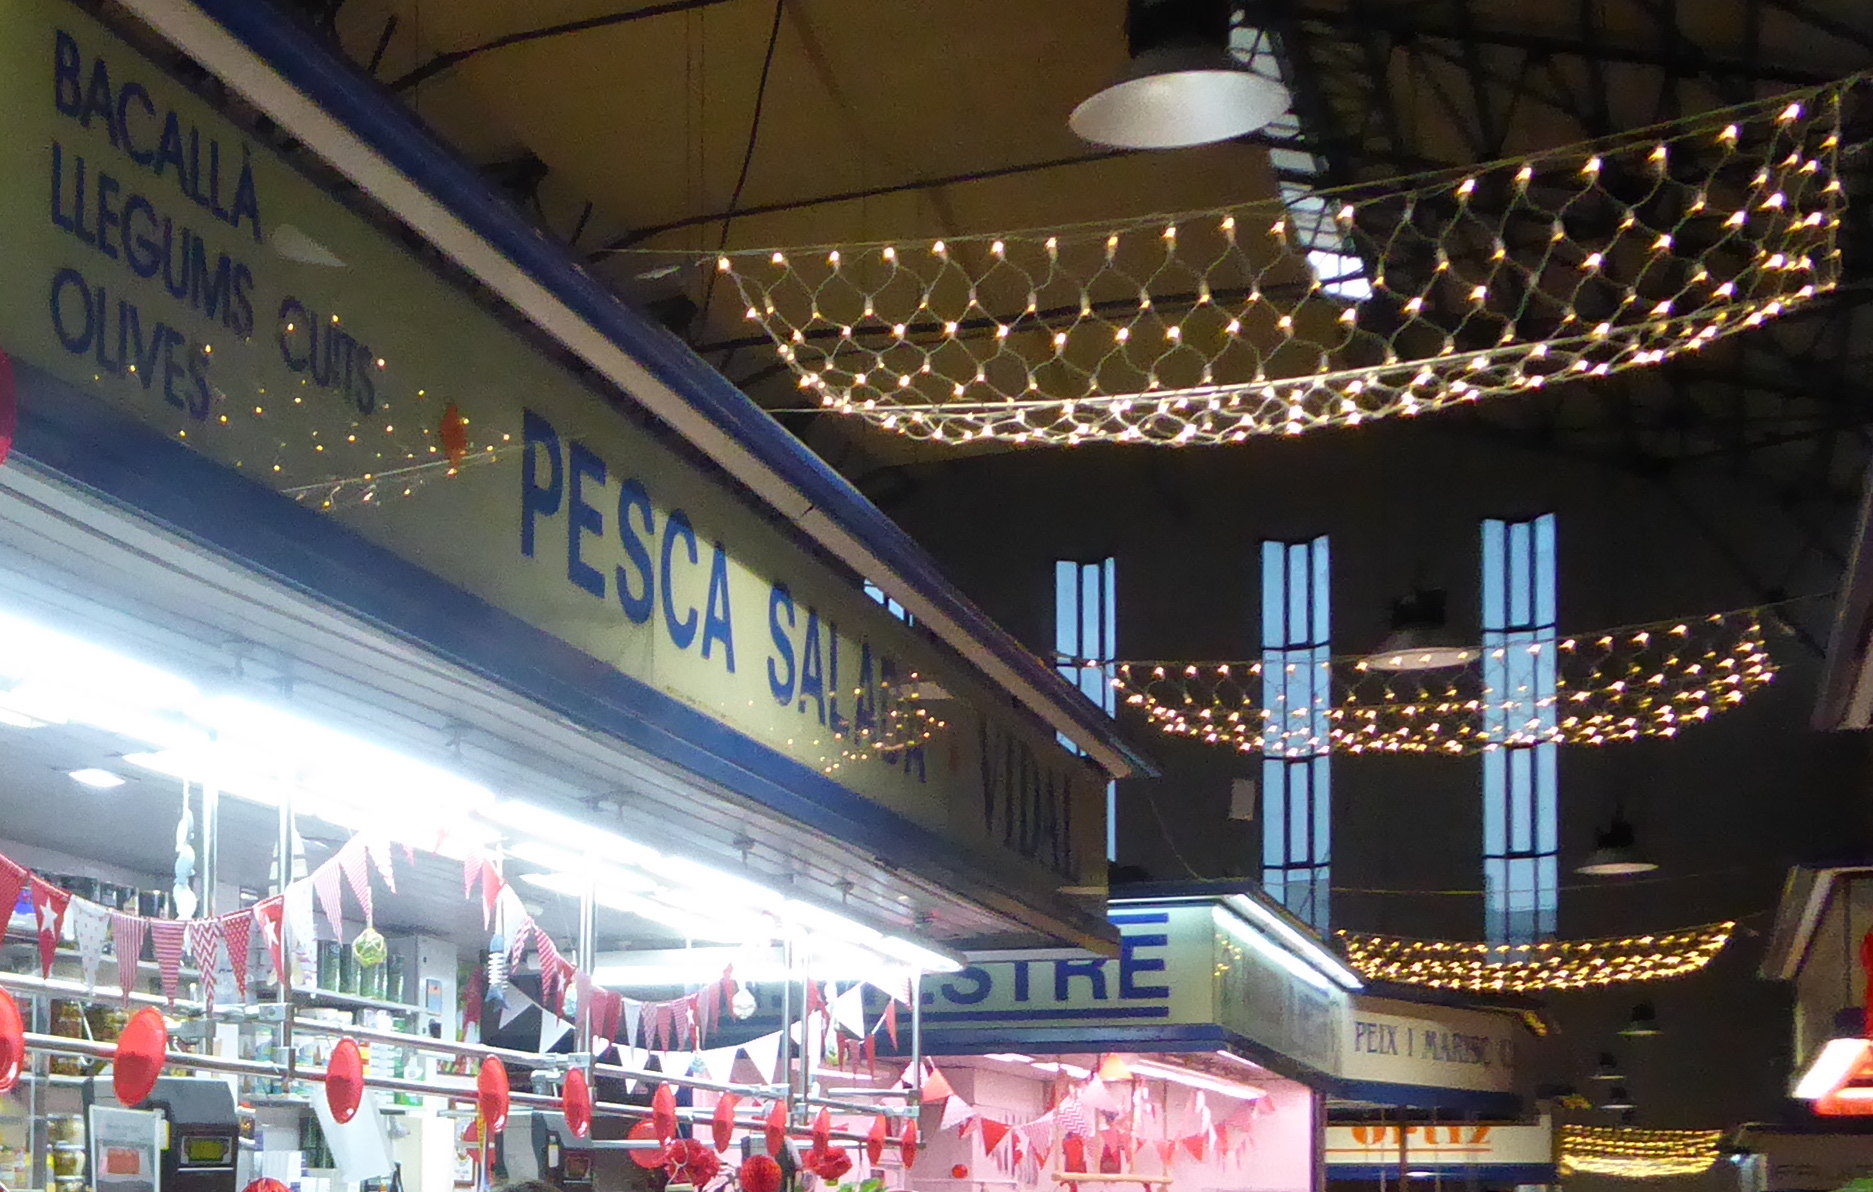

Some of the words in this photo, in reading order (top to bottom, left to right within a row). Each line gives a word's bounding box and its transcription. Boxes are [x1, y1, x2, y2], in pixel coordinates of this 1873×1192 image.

[51, 142, 254, 340] LLEGUMS
[50, 268, 211, 421] OLIVES
[520, 405, 736, 675] PESCA
[1354, 1020, 1399, 1056] PEIX
[1407, 1027, 1415, 1057] I
